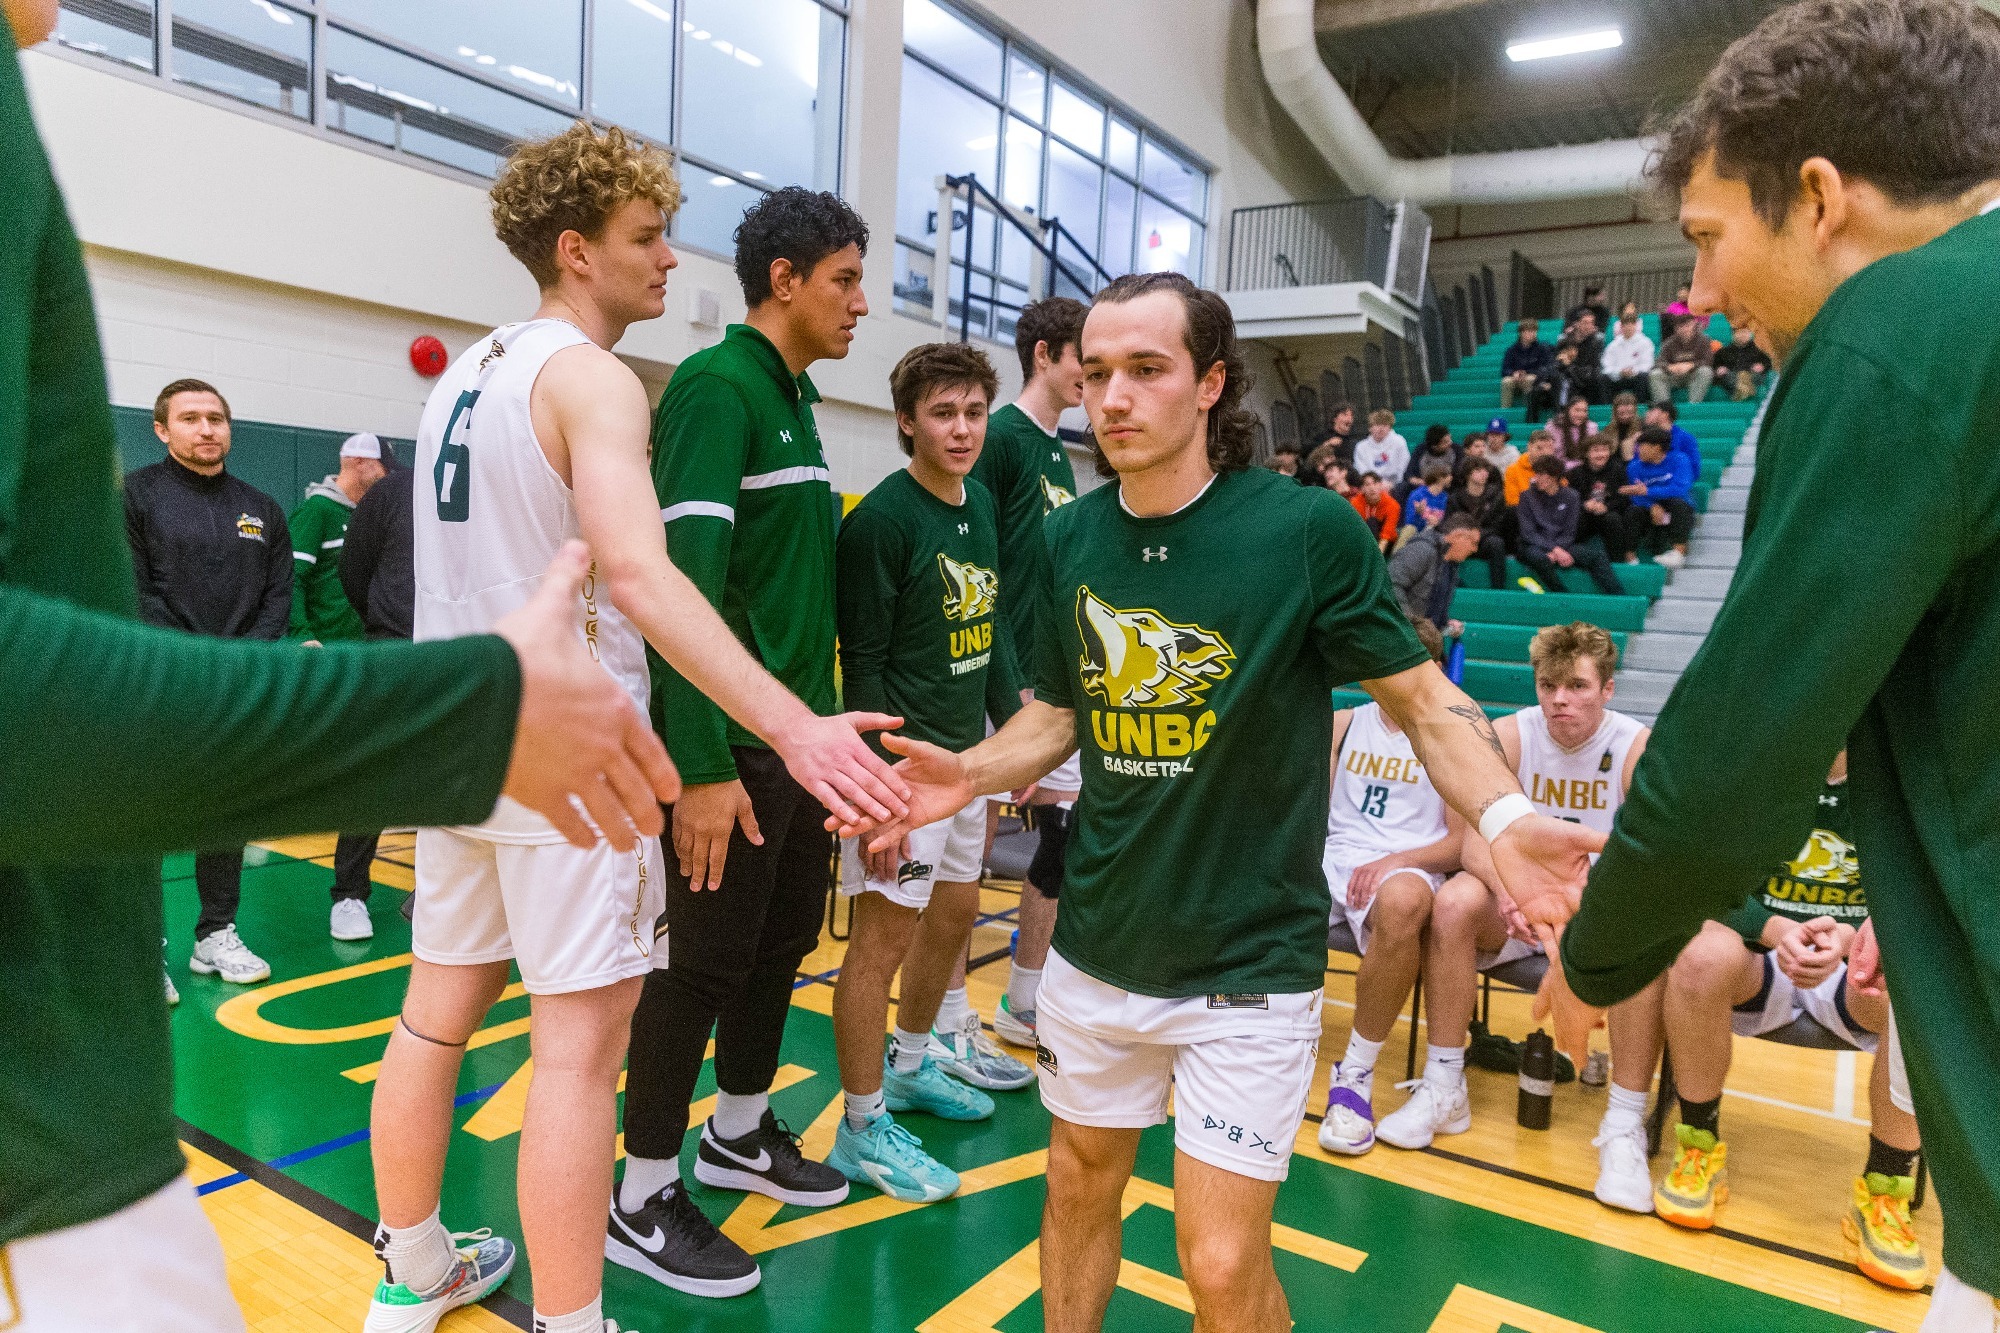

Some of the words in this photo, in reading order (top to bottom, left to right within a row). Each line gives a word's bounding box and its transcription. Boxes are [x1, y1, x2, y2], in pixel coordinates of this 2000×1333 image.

[434, 390, 481, 522] 6
[950, 618, 994, 658] UNB
[1091, 709, 1217, 757] UNBC
[1346, 750, 1422, 784] UNBC
[1360, 784, 1389, 819] 13
[1767, 877, 1867, 905] UNBC
